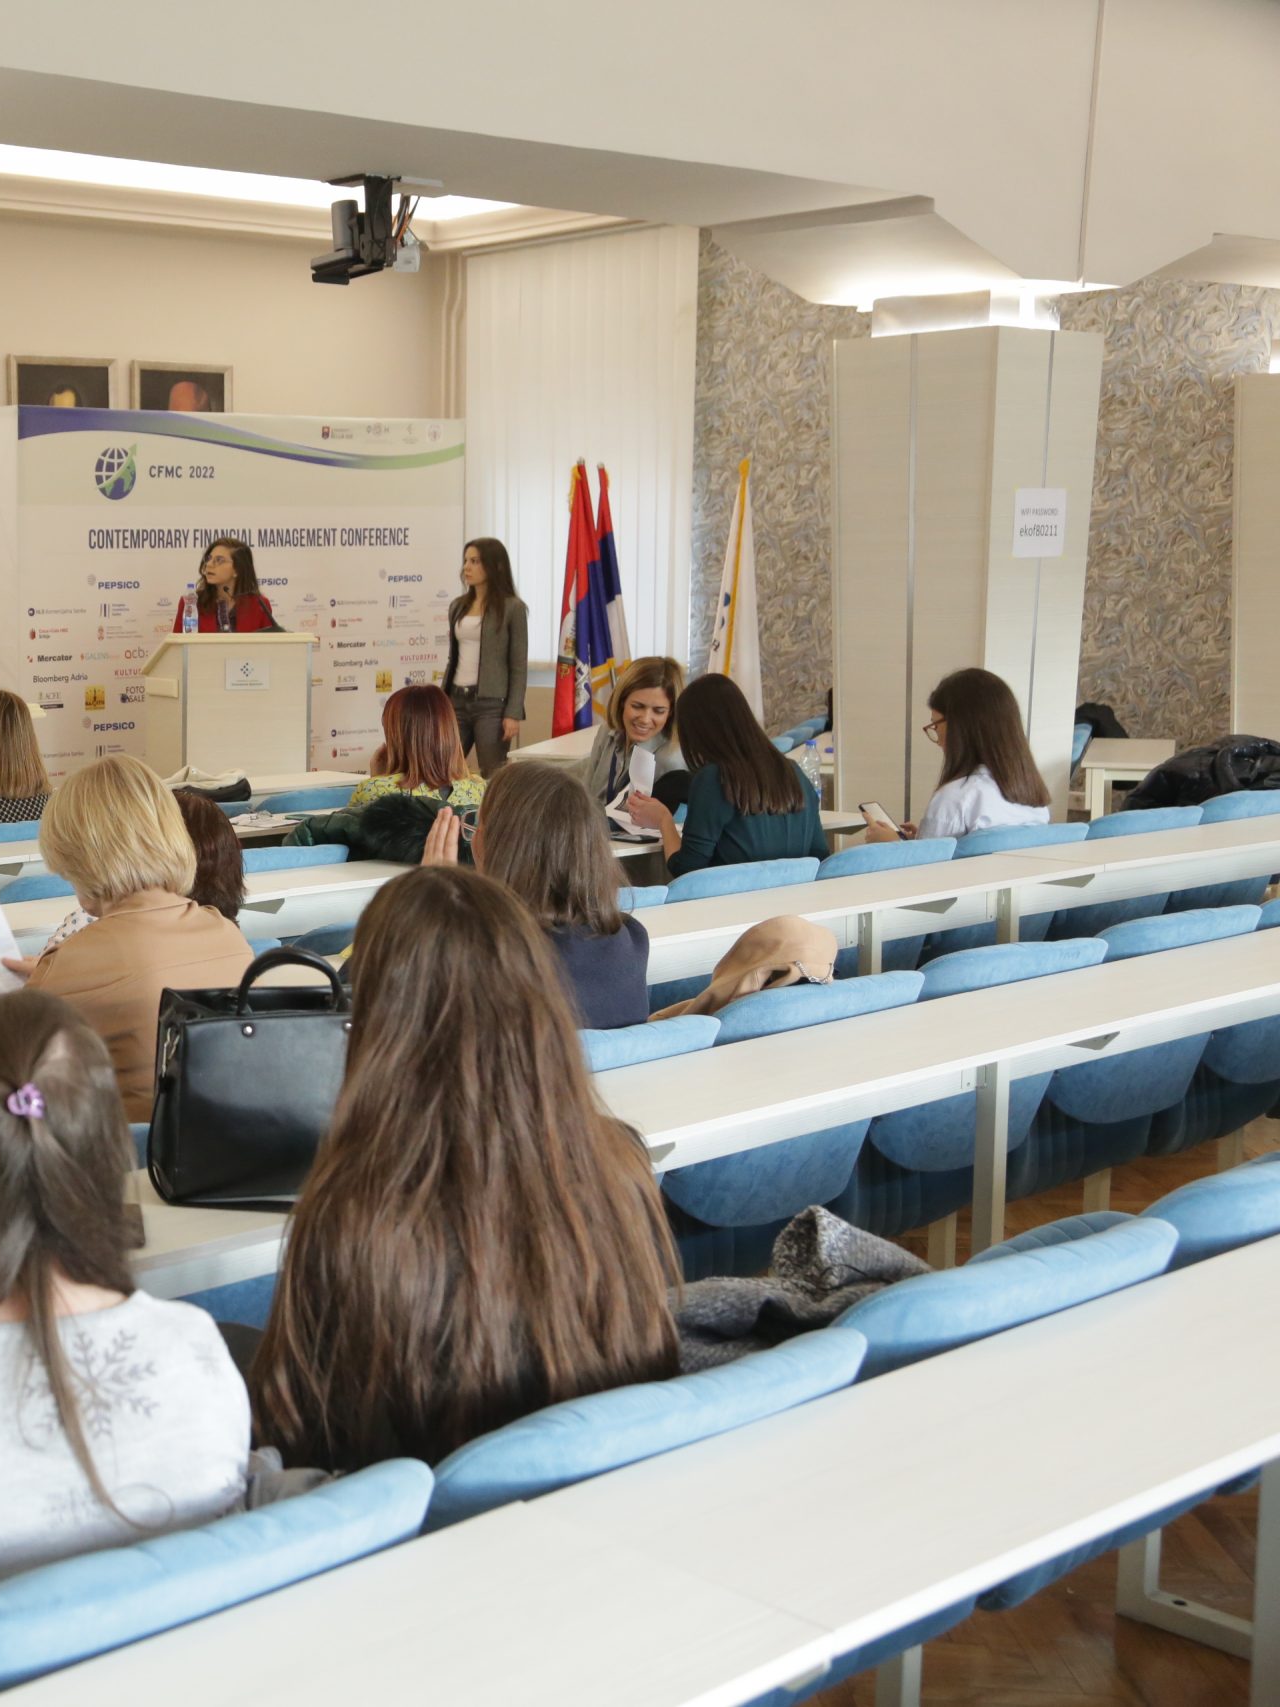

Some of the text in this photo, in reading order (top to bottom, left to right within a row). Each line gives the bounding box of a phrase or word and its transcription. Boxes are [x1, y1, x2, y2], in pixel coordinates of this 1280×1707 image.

[149, 465, 215, 479] CFMC 2022
[88, 529, 190, 550] CONTEMPORARY
[258, 528, 337, 547] MANAGEMENT
[340, 527, 410, 547] CONFERENCE
[256, 577, 289, 586] EPSICO
[387, 574, 423, 583] PEPSICO
[98, 581, 140, 590] PEPSICO
[337, 640, 366, 649] Mercator
[37, 654, 73, 663] Mercator
[333, 659, 363, 668] Bloomberg
[33, 673, 89, 684] Bloomberg Adria
[125, 685, 146, 695] FOTO
[93, 721, 136, 732] PEPSICO
